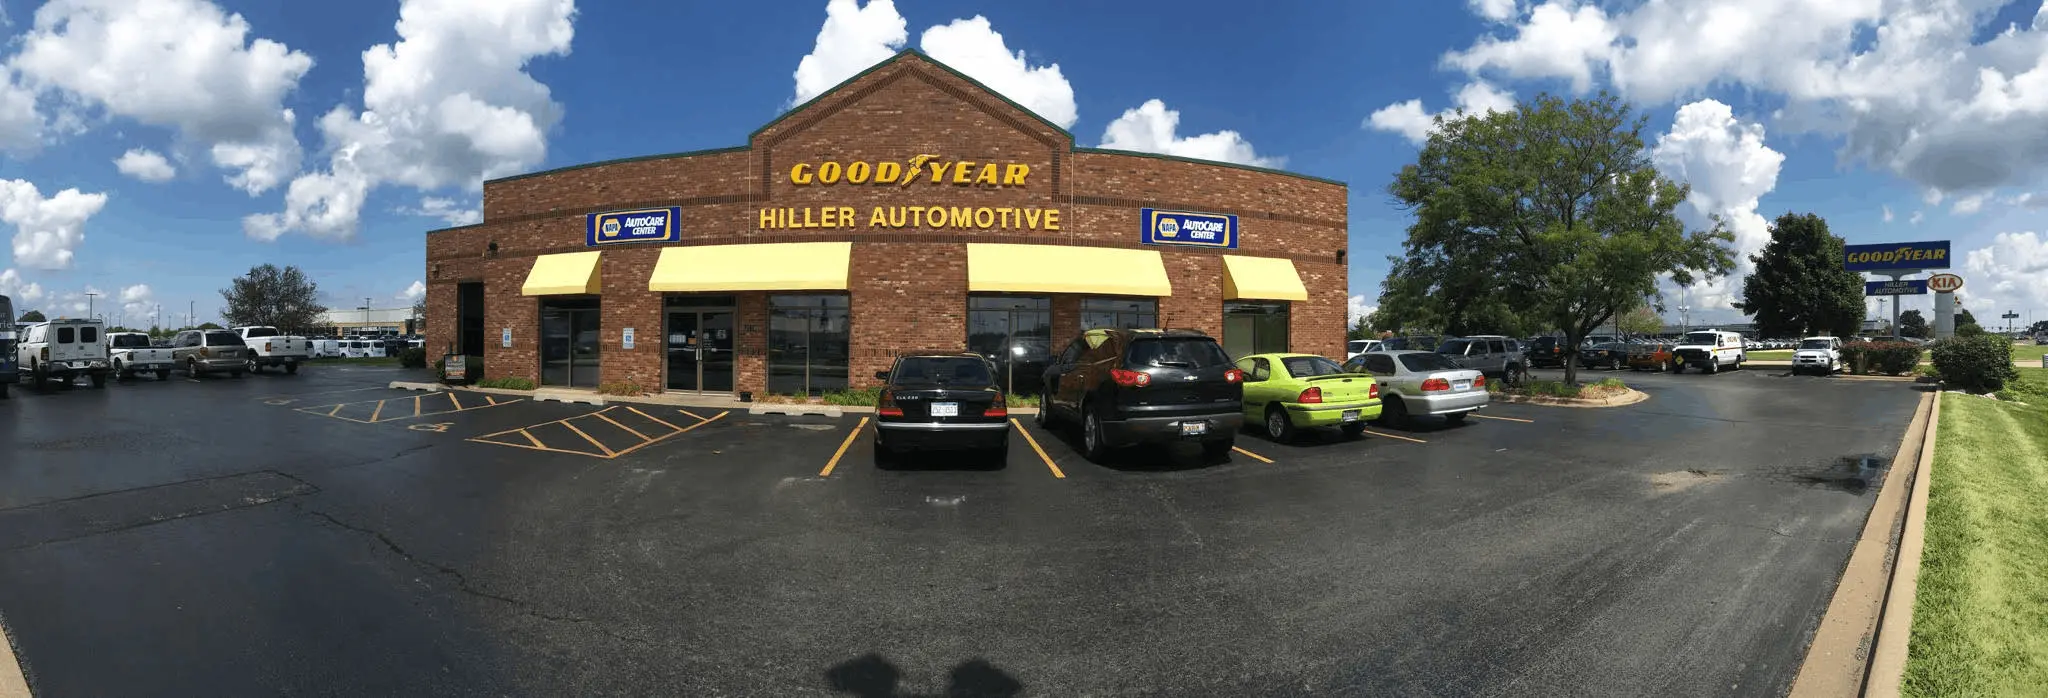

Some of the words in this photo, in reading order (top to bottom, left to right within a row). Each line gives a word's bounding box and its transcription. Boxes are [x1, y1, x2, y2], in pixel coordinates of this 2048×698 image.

[790, 160, 1030, 187] GOODYEAR
[759, 207, 855, 229] HILLER
[869, 207, 1060, 230] AUTOMOTIVE
[605, 223, 618, 232] NAPA
[632, 227, 656, 235] CENTER
[1161, 223, 1177, 232] NAPA
[1190, 230, 1215, 240] CENTER
[1847, 247, 1946, 263] GOODYEAR
[1932, 277, 1957, 289] KIA
[1874, 286, 1918, 294] AUTOMOTIVE
